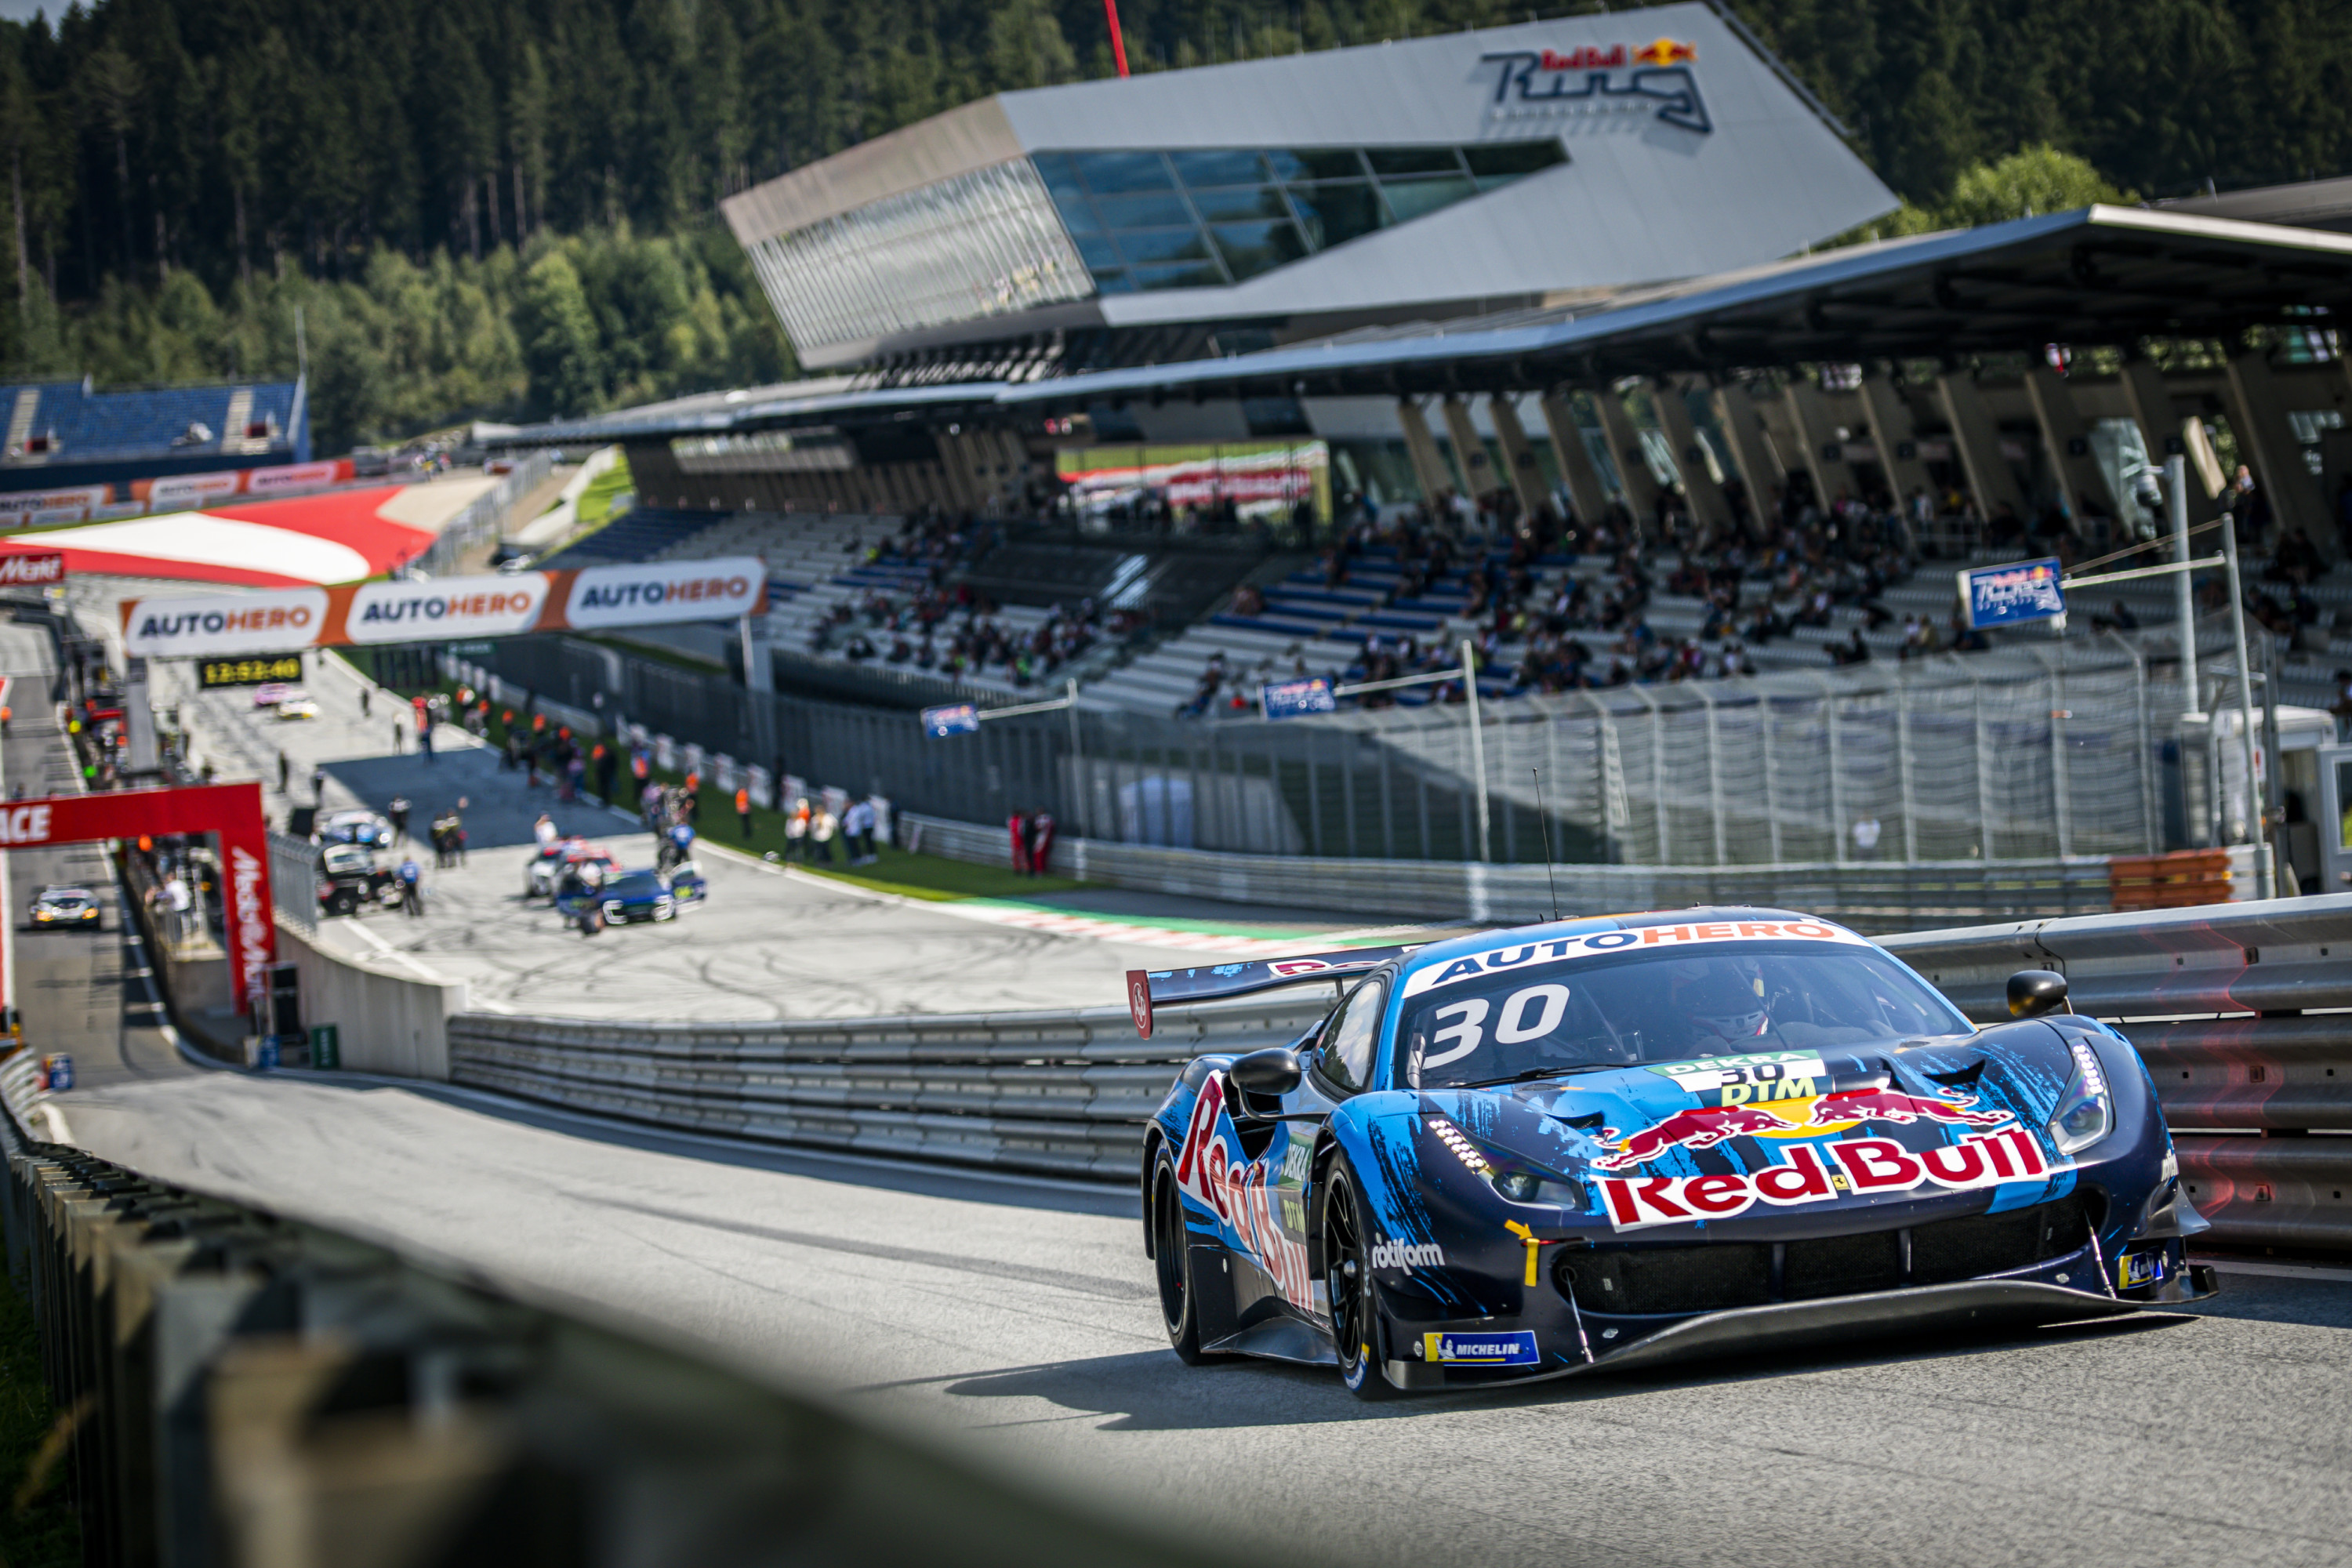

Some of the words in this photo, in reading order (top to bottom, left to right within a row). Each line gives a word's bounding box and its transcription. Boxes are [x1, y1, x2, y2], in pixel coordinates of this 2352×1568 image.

[362, 591, 532, 624] AUTOHERO
[580, 575, 749, 608] AUTOHERO
[139, 604, 311, 639] AUTOHERO
[1433, 923, 1835, 986] AUTOHERO
[1422, 984, 1570, 1070] 30
[1664, 1052, 1810, 1075] DEKRA
[1722, 1076, 1817, 1108] DTM
[1283, 1142, 1310, 1181] DEKRA
[1603, 1146, 1831, 1225] Red
[1839, 1127, 2045, 1189] Bull
[1372, 1238, 1446, 1276] rotiform
[1456, 1343, 1520, 1355] MICHELIN
